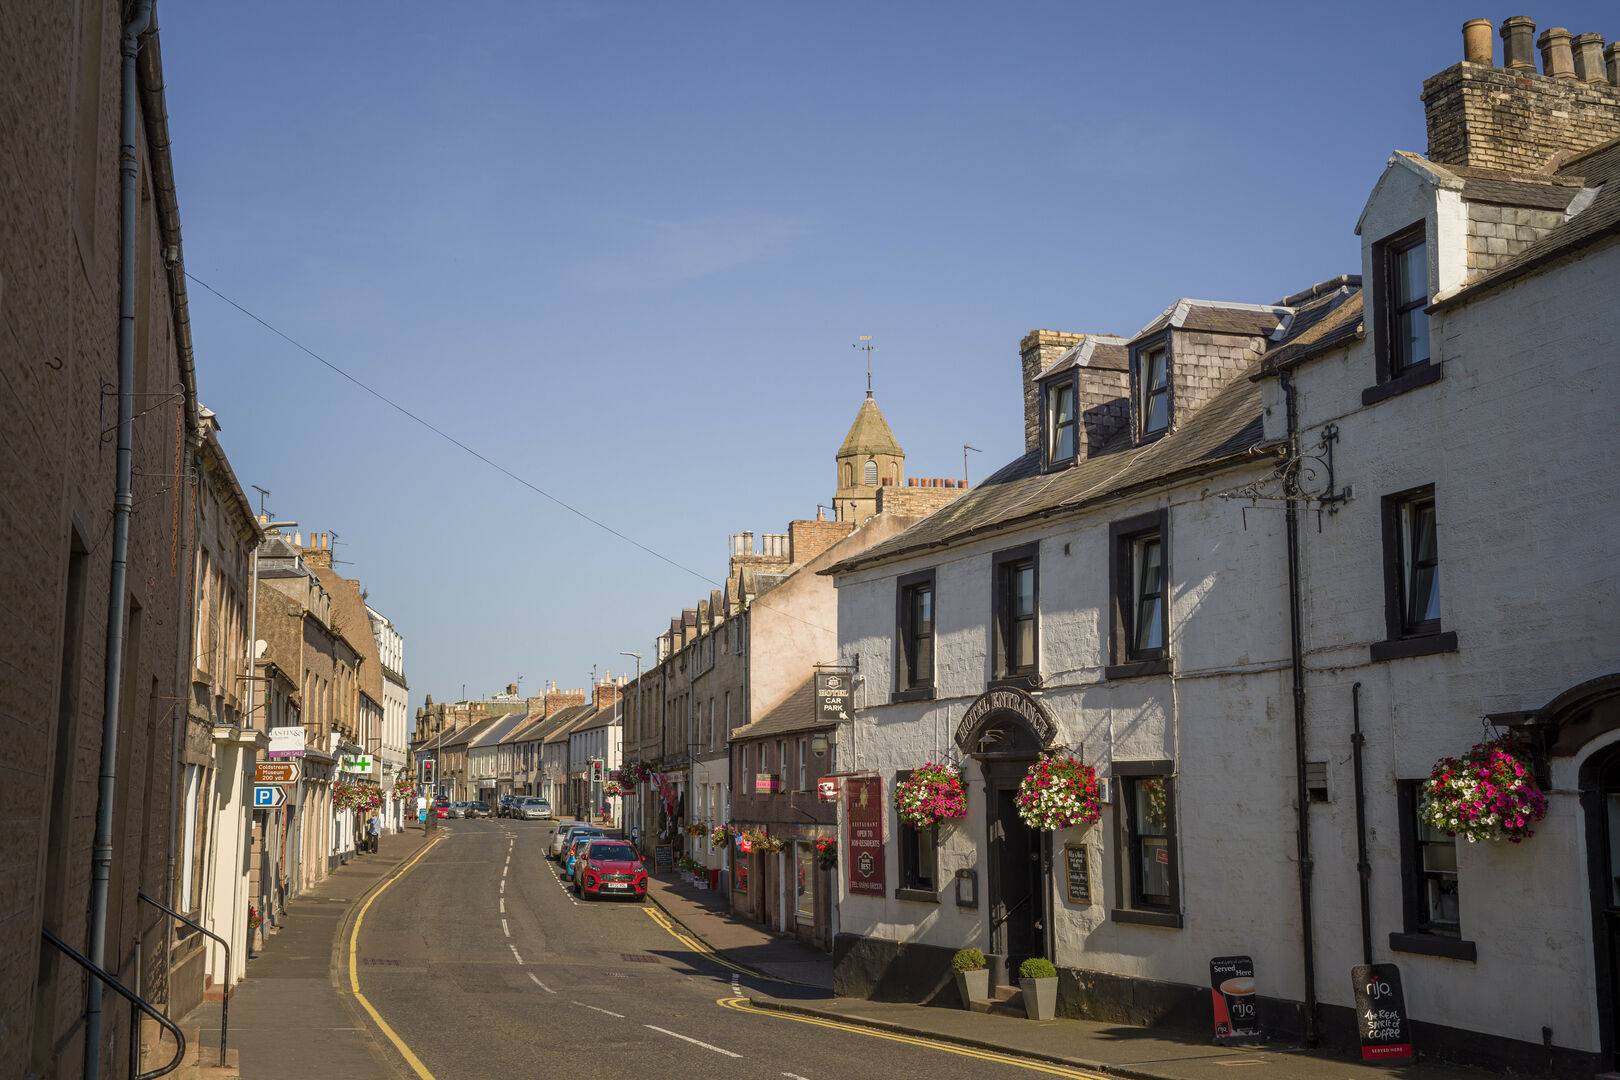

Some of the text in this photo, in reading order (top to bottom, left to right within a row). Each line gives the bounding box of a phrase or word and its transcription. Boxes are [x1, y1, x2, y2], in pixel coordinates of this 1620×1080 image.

[818, 689, 849, 697] HOTEL
[957, 691, 1049, 743] HOTEL ENTRANCE
[259, 790, 270, 804] P
[1214, 965, 1236, 973] Served
